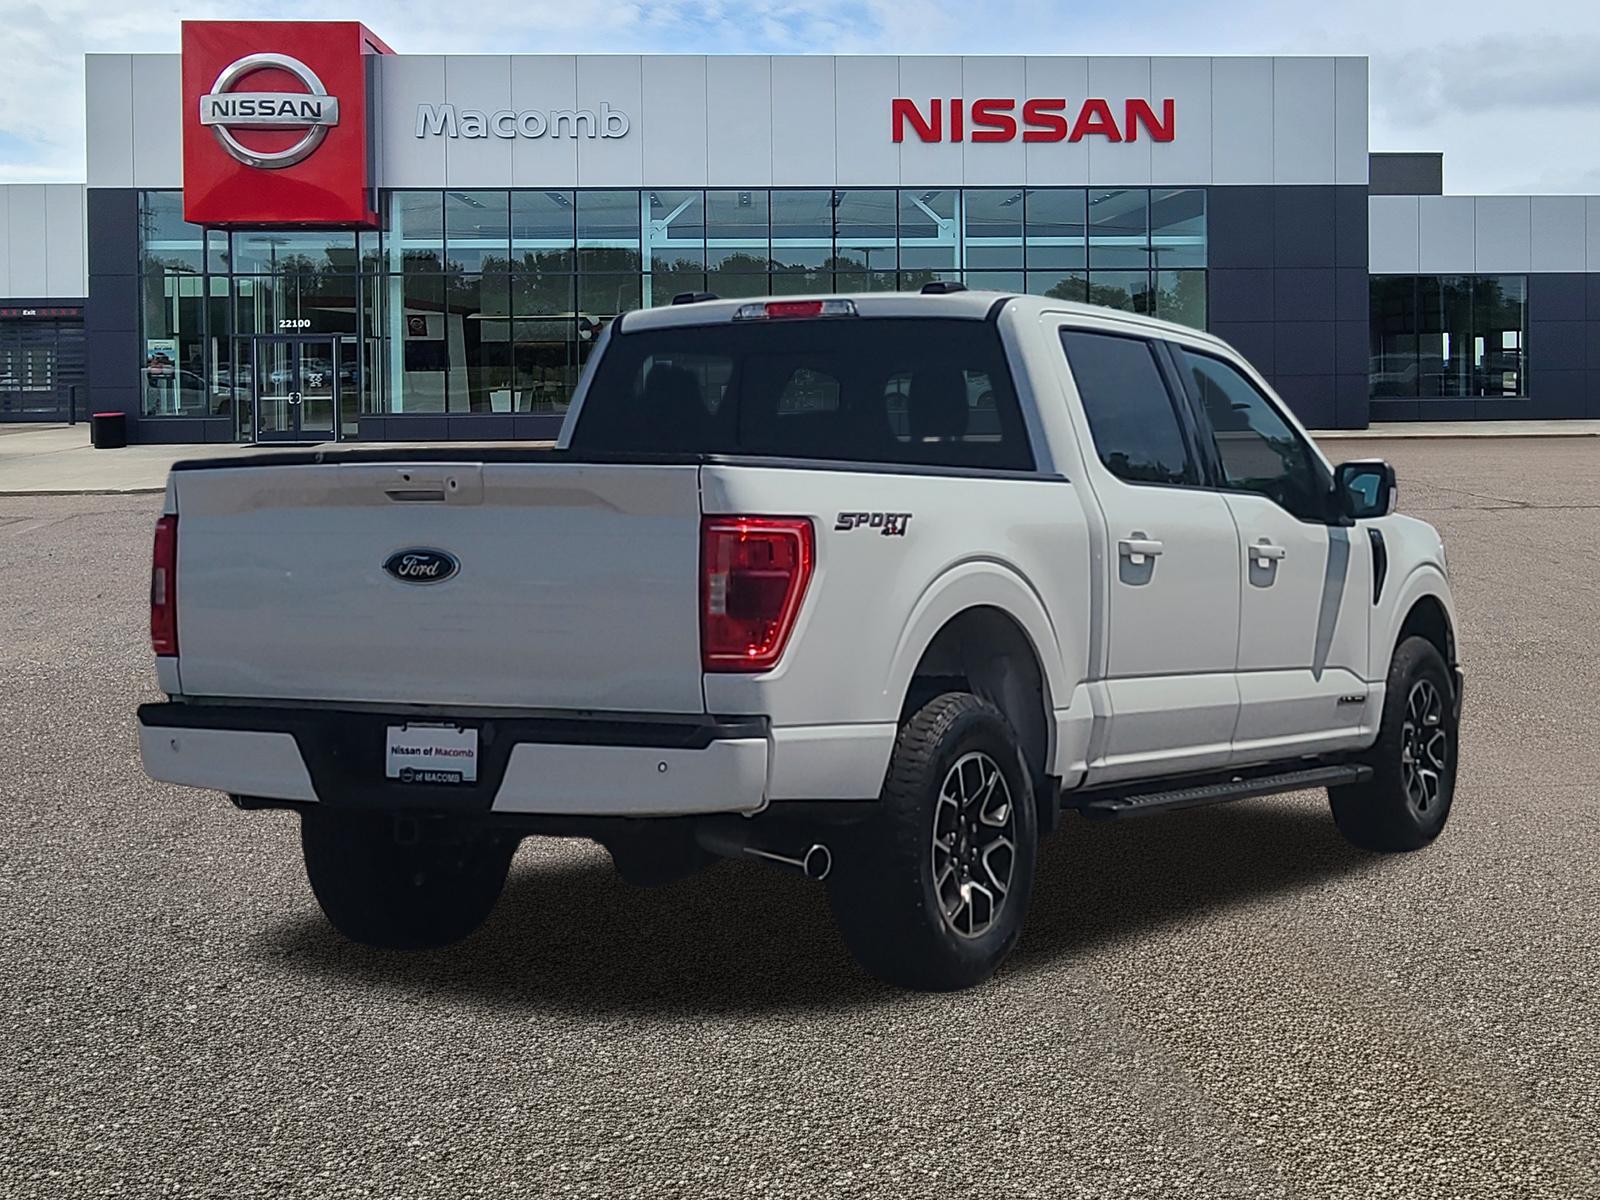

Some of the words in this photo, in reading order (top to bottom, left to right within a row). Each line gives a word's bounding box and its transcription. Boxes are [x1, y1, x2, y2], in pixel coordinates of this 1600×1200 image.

[212, 100, 322, 117] NISSAN
[415, 102, 630, 139] Macomb
[892, 98, 1175, 143] NISSAN
[279, 319, 311, 328] 22100
[834, 512, 912, 532] SPORT
[398, 554, 441, 576] Ford
[391, 745, 421, 756] Nissan
[423, 747, 433, 756] of
[435, 748, 474, 758] Macomb
[424, 772, 460, 783] MACOMB
